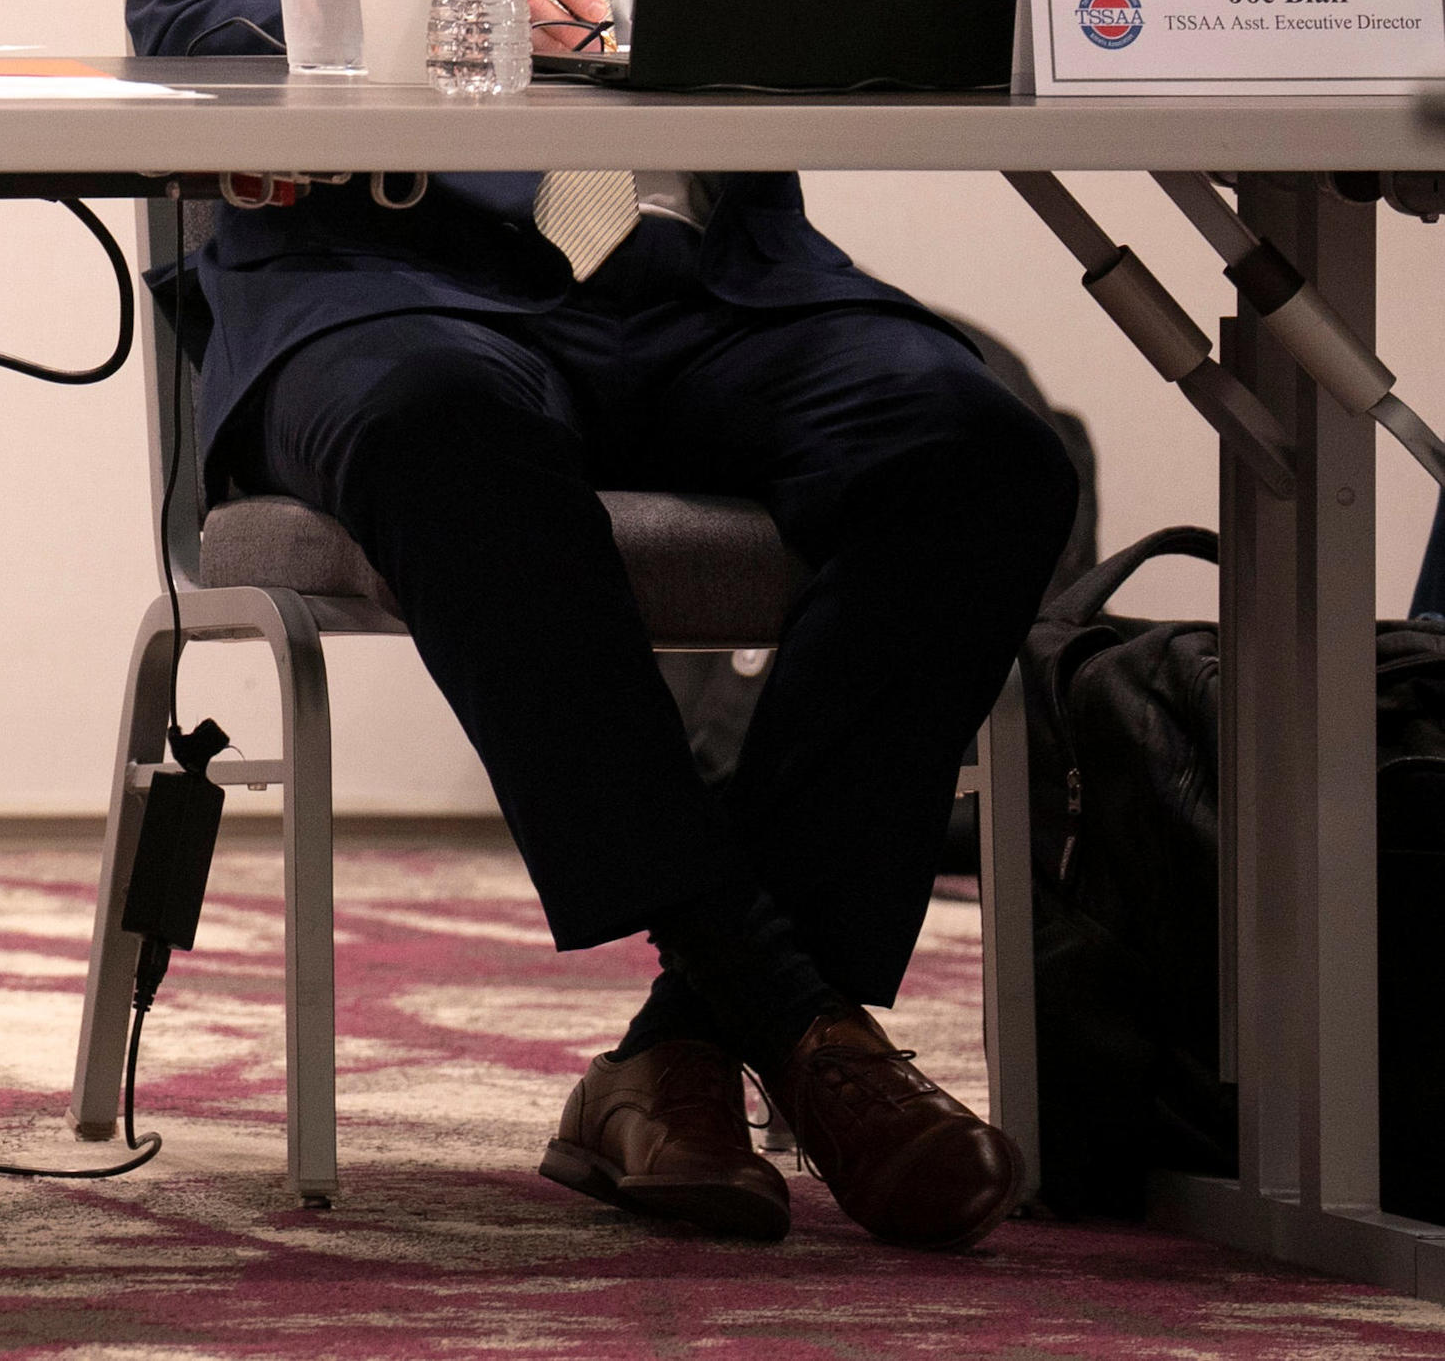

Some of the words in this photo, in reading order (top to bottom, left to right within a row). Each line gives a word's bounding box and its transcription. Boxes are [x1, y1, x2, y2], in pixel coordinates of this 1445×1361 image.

[1074, 9, 1146, 25] TSSAA
[1164, 15, 1225, 30] TSSAA
[1231, 15, 1269, 30] Asst.
[1275, 14, 1353, 30] Executive
[1358, 13, 1422, 30] Director
